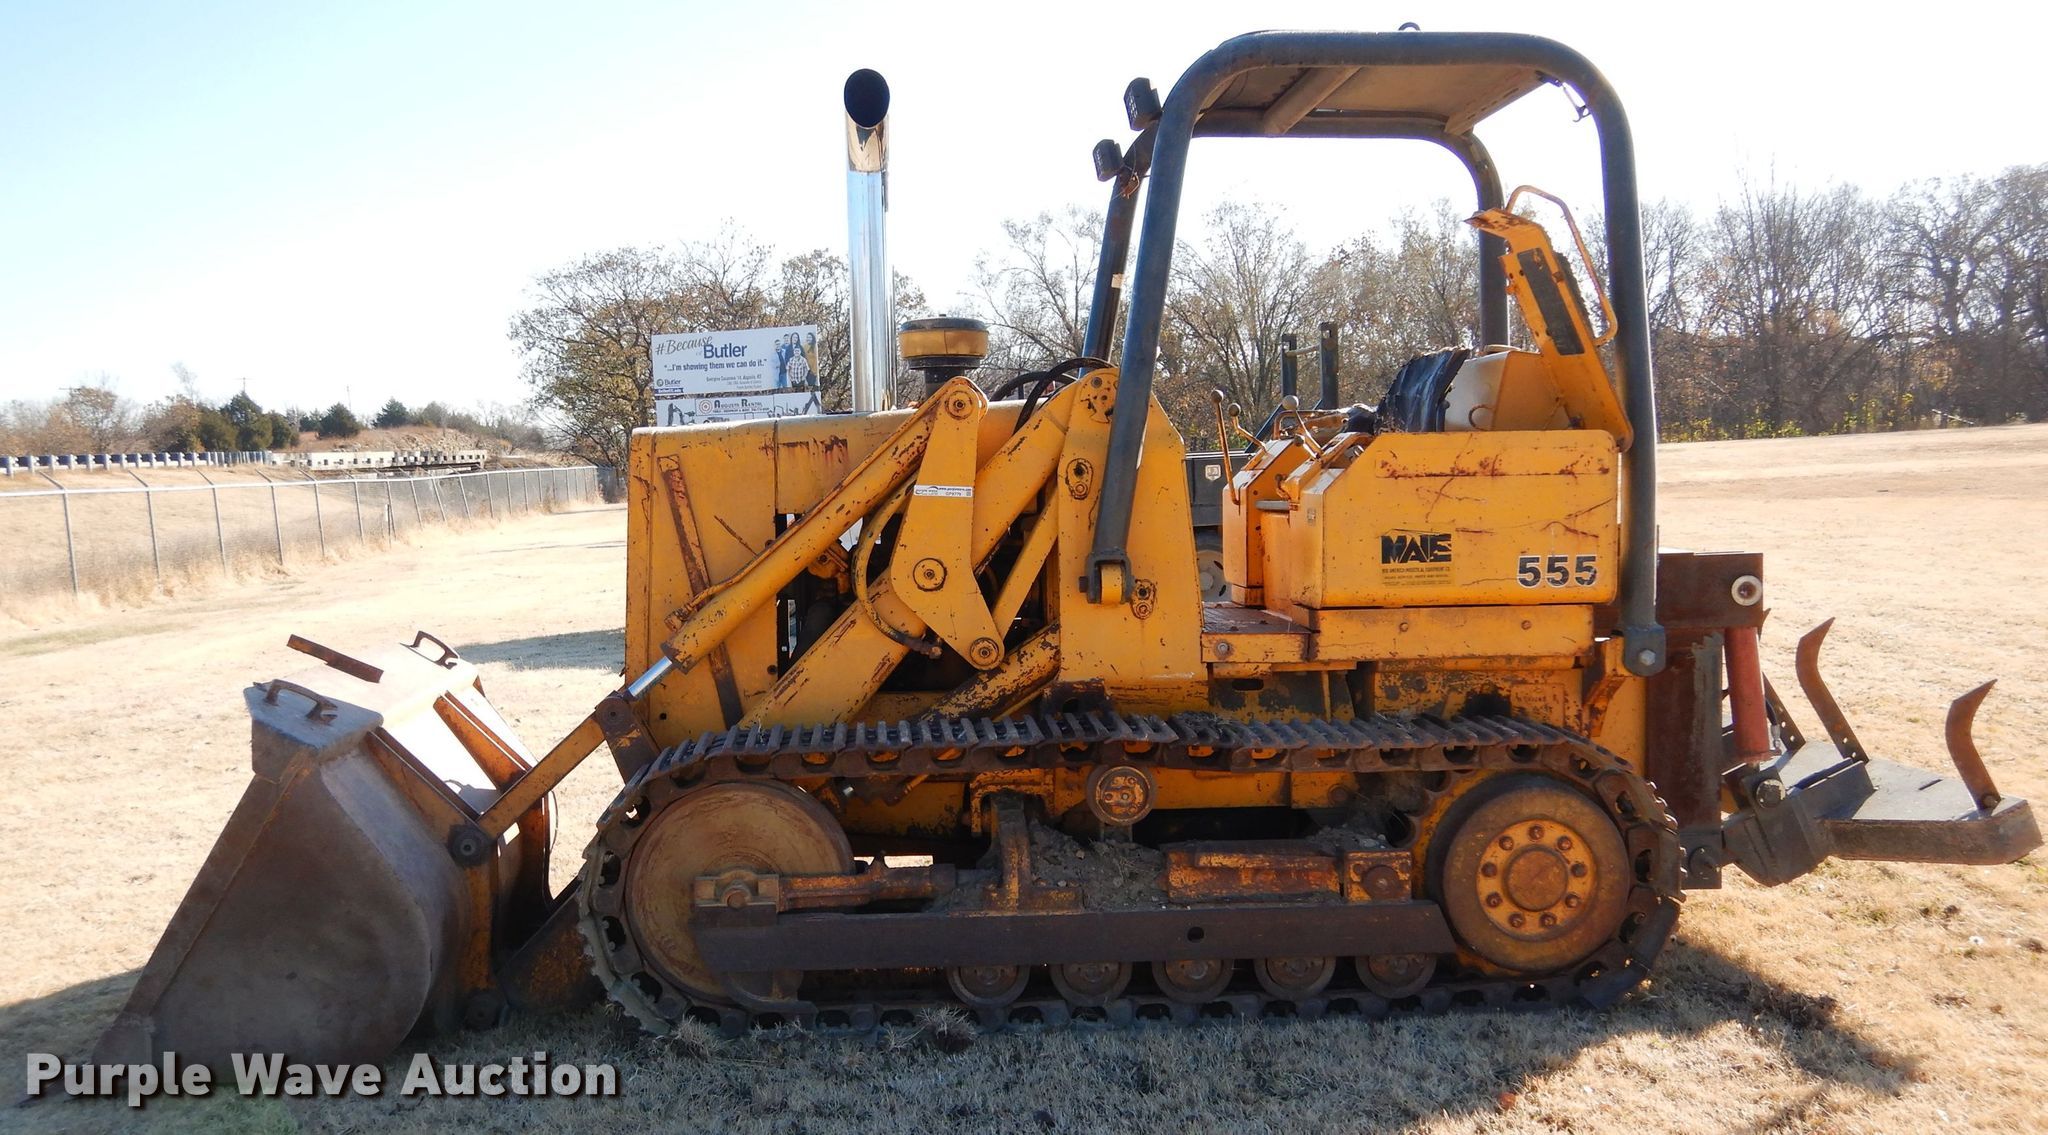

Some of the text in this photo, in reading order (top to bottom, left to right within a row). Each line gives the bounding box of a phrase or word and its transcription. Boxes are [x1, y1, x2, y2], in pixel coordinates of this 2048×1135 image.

[655, 336, 713, 355] #Because
[703, 343, 747, 359] Butler
[683, 363, 708, 371] showing
[709, 361, 725, 369] them
[749, 359, 756, 367] do
[1517, 554, 1597, 589] 555
